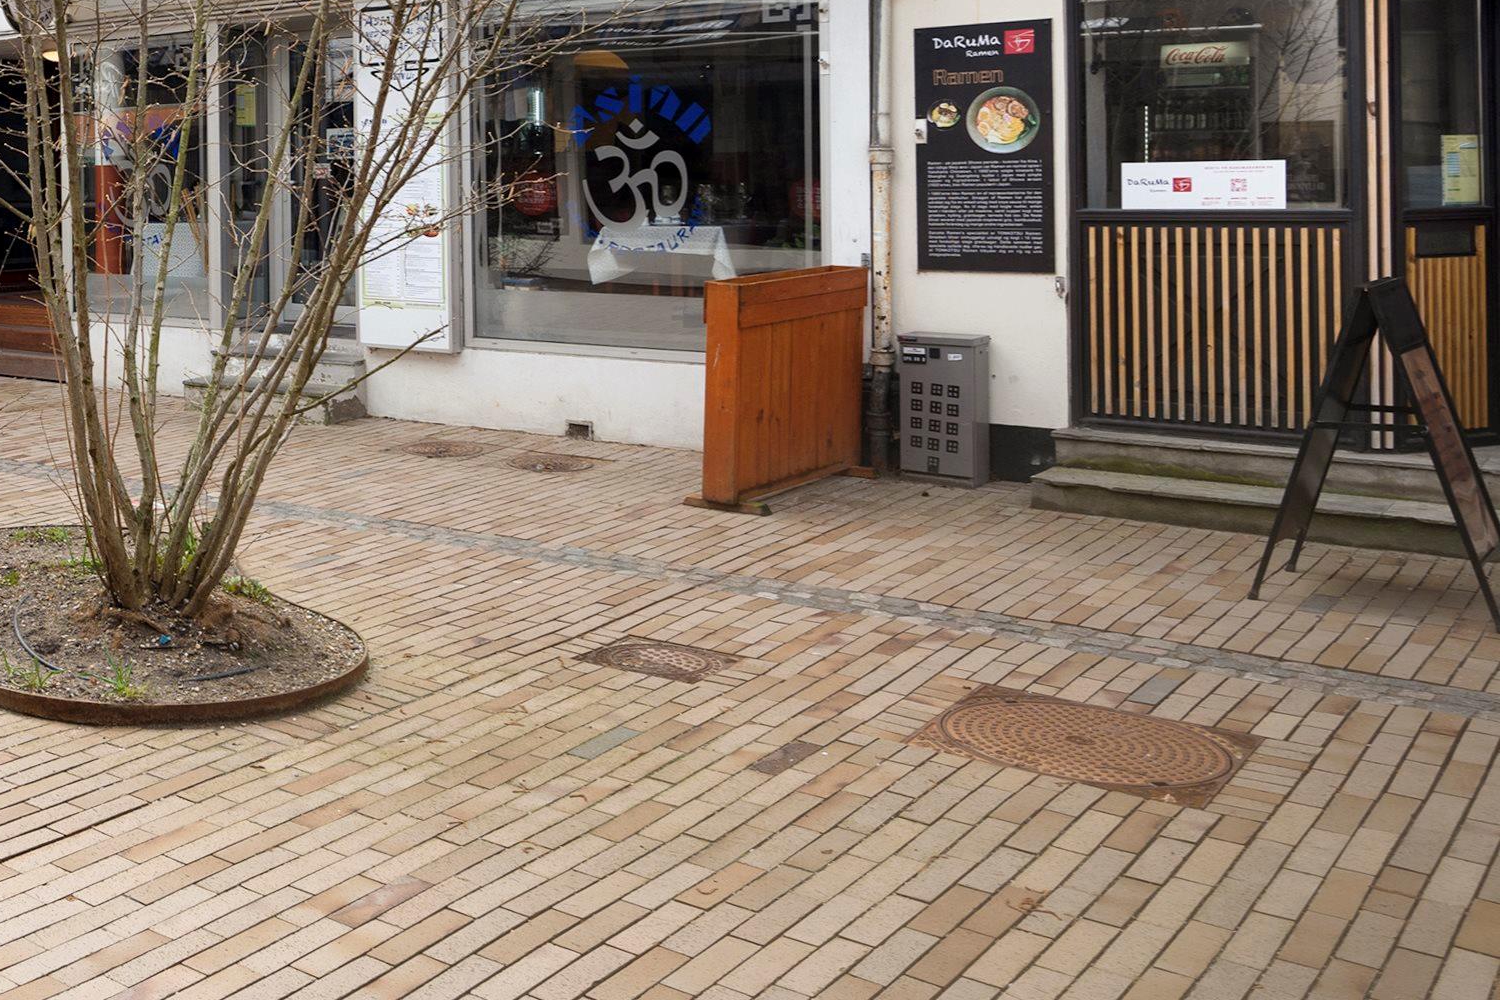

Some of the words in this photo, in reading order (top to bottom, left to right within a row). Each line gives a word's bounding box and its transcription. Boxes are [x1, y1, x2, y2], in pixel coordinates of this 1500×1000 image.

[931, 34, 1002, 49] DaRuMa
[965, 49, 999, 57] Ramen
[932, 68, 1004, 86] Ramen
